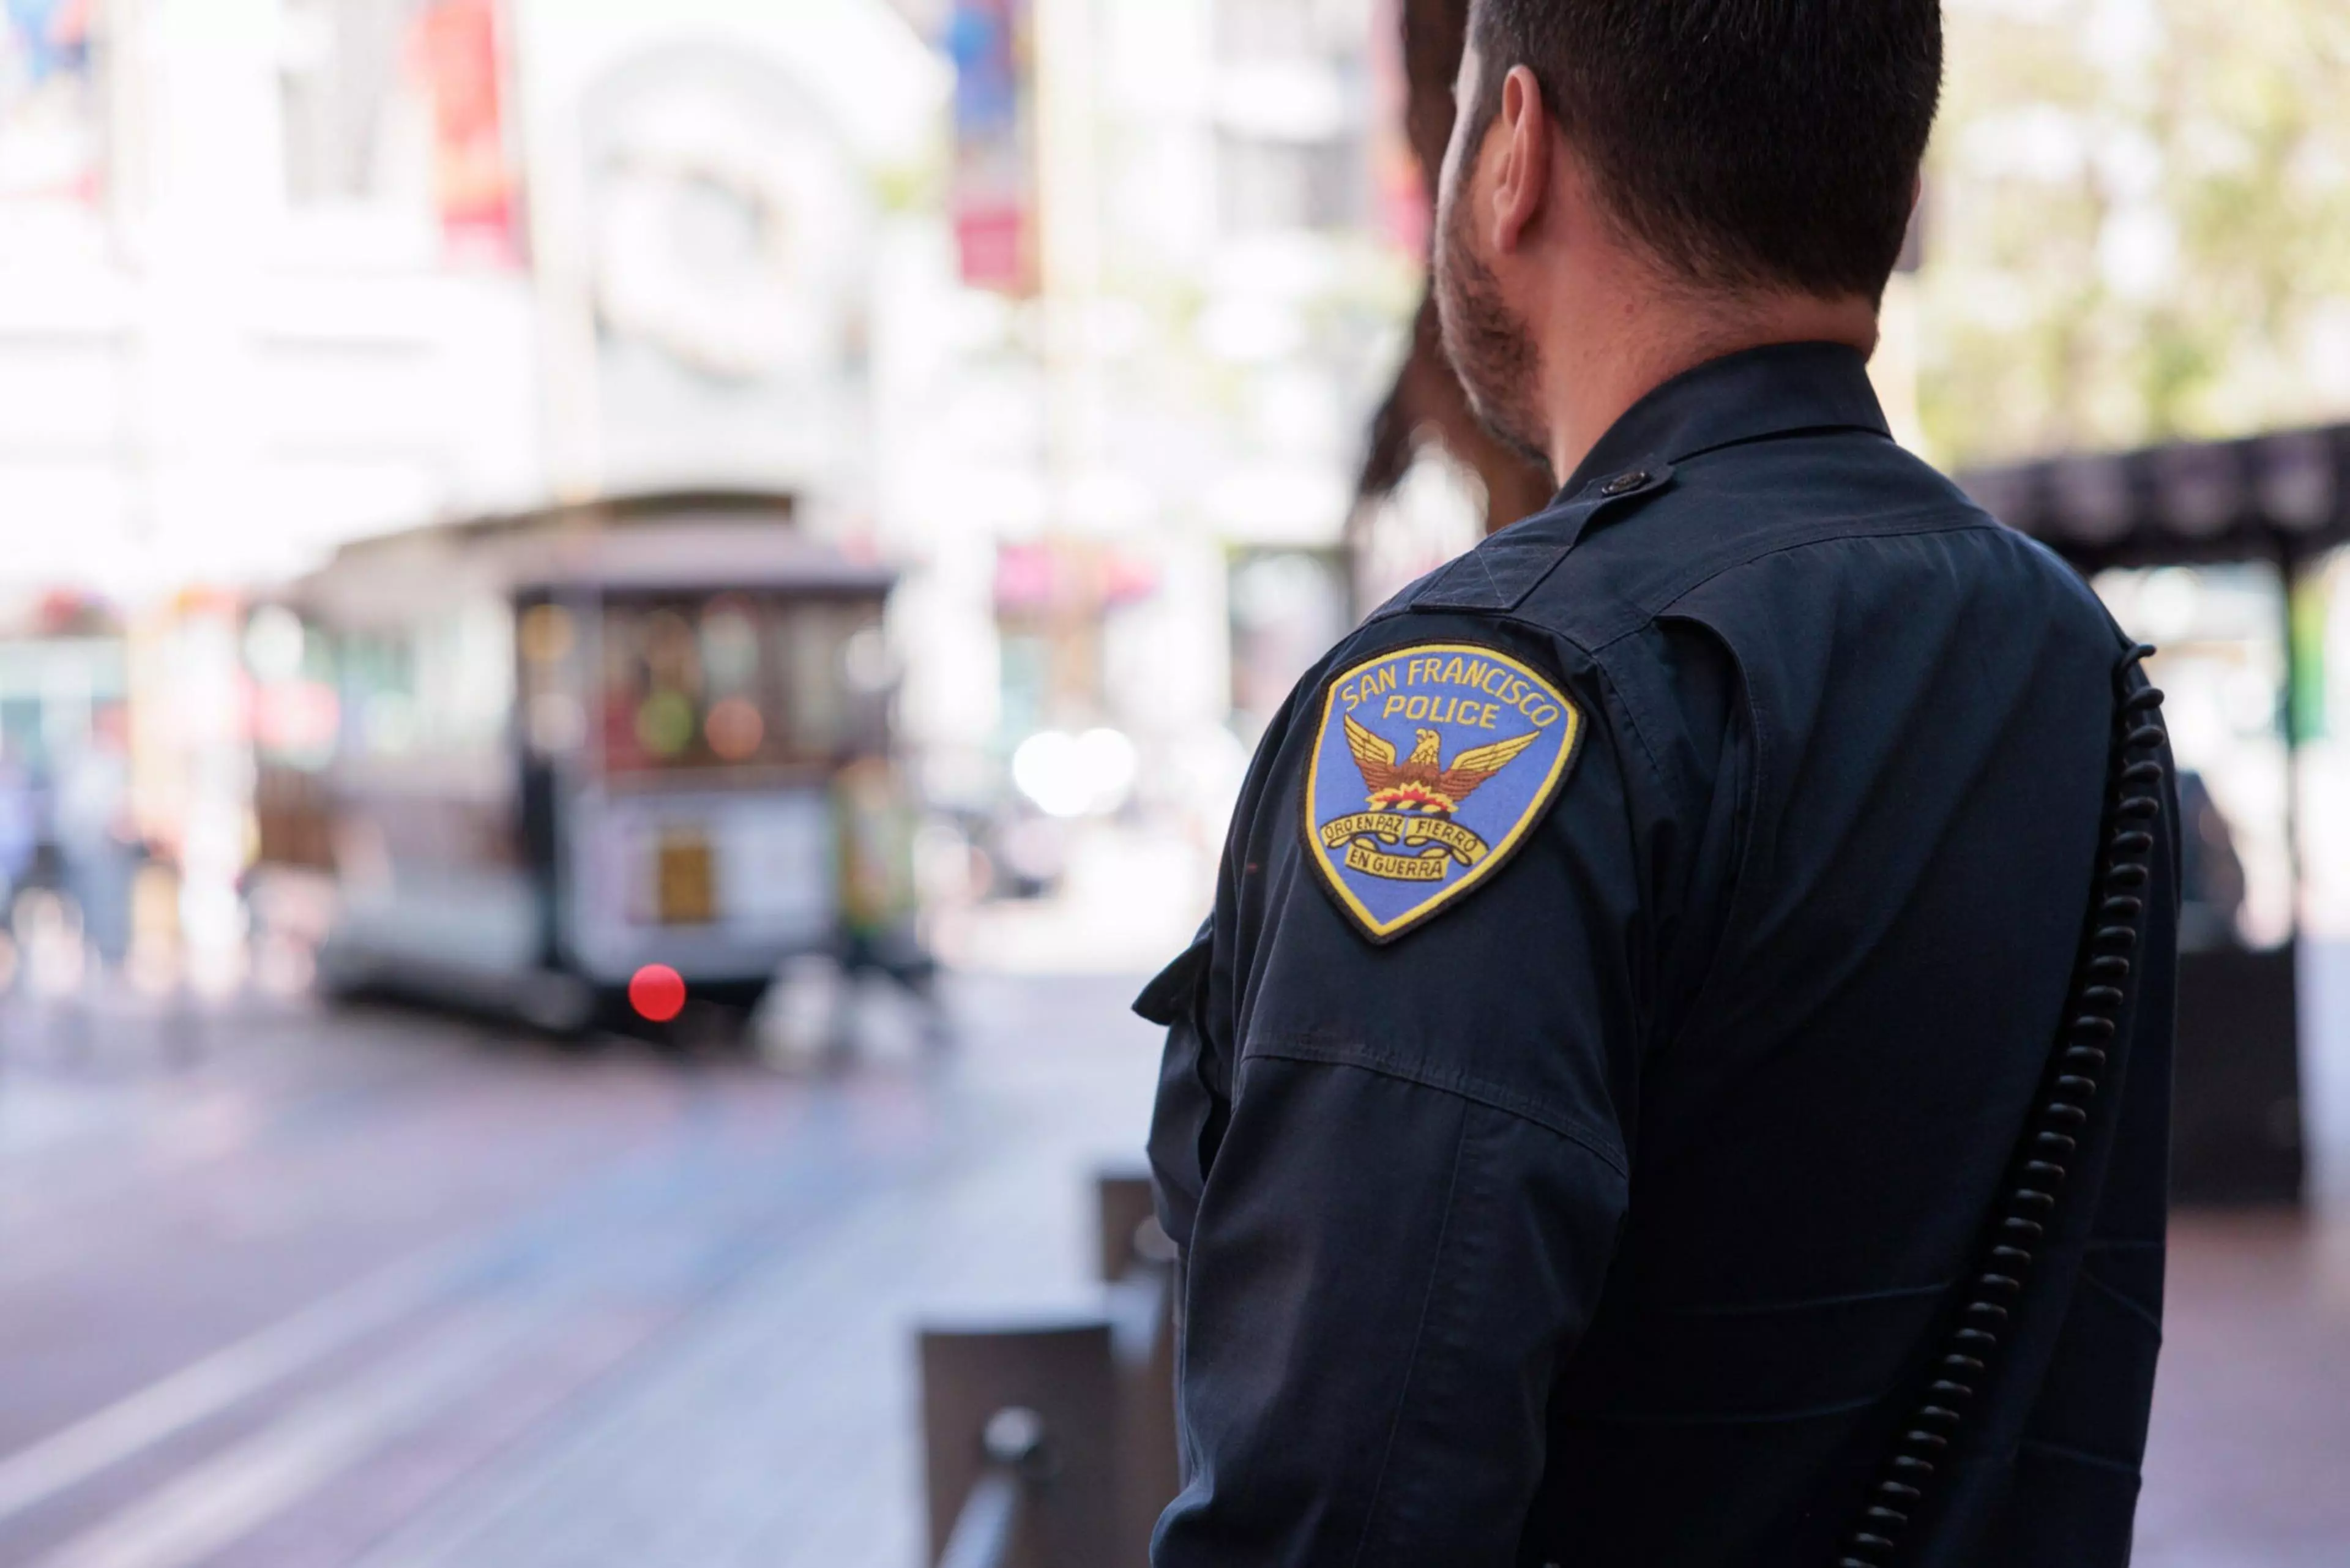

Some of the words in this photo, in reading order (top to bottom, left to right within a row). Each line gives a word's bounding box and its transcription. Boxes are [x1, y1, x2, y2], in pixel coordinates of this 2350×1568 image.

[1341, 665, 1397, 711] SAN
[1408, 657, 1559, 727] FRANCISCO
[1382, 695, 1501, 729] POLICE
[1324, 819, 1352, 838] ORO
[1356, 816, 1374, 830] EN
[1376, 816, 1403, 832] PAZ
[1416, 819, 1478, 853] FIERRO
[1350, 849, 1370, 865] EN
[1373, 856, 1443, 877] GUERRA
